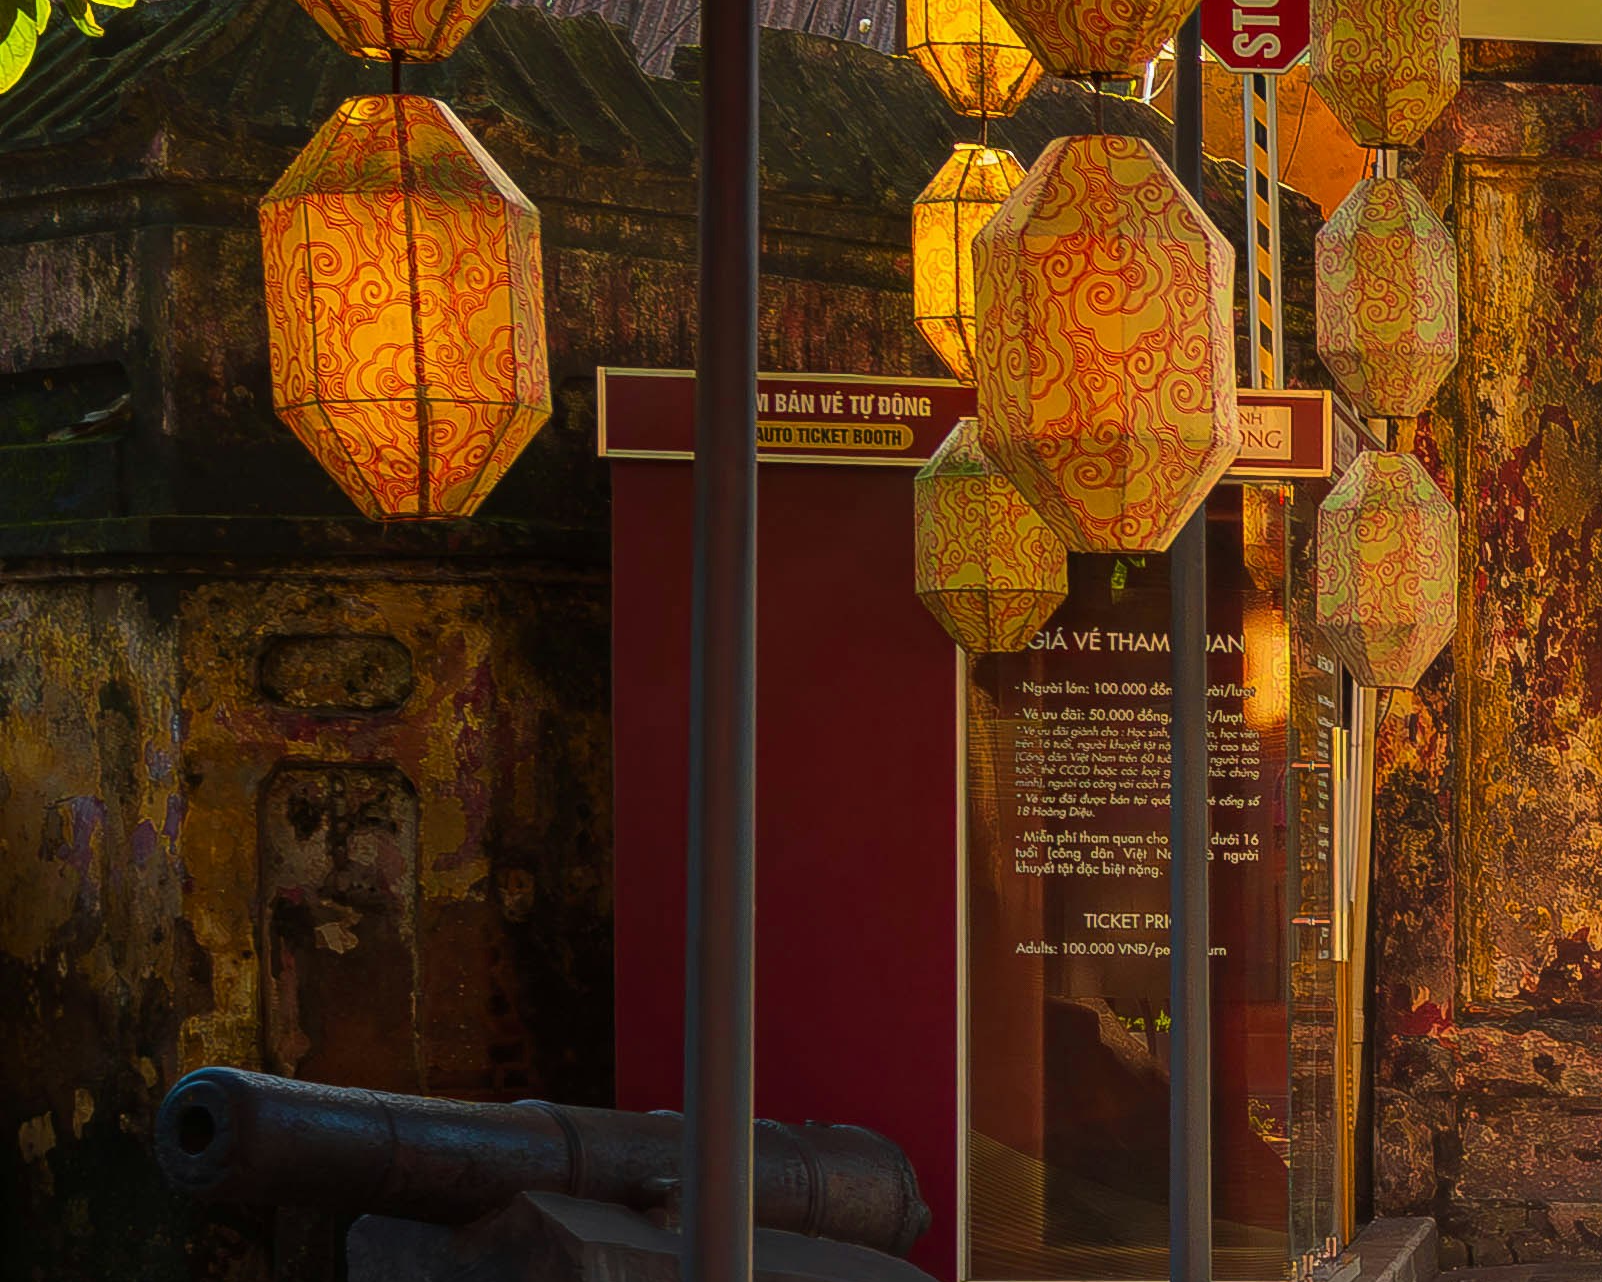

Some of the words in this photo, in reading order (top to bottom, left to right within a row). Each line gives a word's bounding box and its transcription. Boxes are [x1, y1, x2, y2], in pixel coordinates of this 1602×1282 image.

[775, 389, 815, 414] BÁN
[821, 391, 844, 414] VÉ
[849, 393, 874, 419] TỰ
[878, 393, 932, 420] ĐỘNG
[757, 427, 793, 442] AUTO
[798, 428, 849, 445] TICKET
[853, 429, 902, 445] BOOTH
[1027, 626, 1068, 650] GIÁ
[1073, 627, 1101, 652] VÉ
[1107, 631, 1170, 652] THAM
[1023, 681, 1062, 697] Người
[1066, 680, 1090, 695] lớn:
[1095, 682, 1147, 695] 100.000
[1061, 706, 1085, 721] đãi:
[1089, 709, 1134, 722] 50.000
[1101, 725, 1118, 737] cho
[1091, 752, 1115, 762] Nam
[1140, 753, 1154, 763] 60
[1059, 764, 1090, 775] CCCD
[1208, 766, 1226, 777] hác
[1093, 779, 1116, 791] công
[1080, 793, 1107, 806] được
[1247, 795, 1262, 806] số
[1016, 806, 1031, 816] 18
[1032, 806, 1067, 819] Hoàng
[1023, 829, 1054, 844] Miễn
[1057, 830, 1077, 846] phí
[1079, 830, 1110, 844] tham
[1113, 834, 1143, 846] quan
[1146, 831, 1168, 845] cho
[1211, 832, 1240, 845] dưới
[1244, 833, 1259, 845] 16
[1015, 844, 1038, 859] tuổi
[1090, 846, 1114, 859] dân
[1123, 847, 1148, 862] Việt
[1223, 849, 1260, 864] người
[1015, 860, 1054, 877] khuyết
[1058, 862, 1074, 877] tật
[1076, 862, 1099, 877] đặc
[1102, 861, 1125, 877] biệt
[1128, 864, 1163, 878] nặng.
[1084, 913, 1140, 929] TICKET
[1145, 913, 1172, 929] PRI
[1015, 941, 1058, 955] Adults:
[1062, 942, 1114, 955] 100.000
